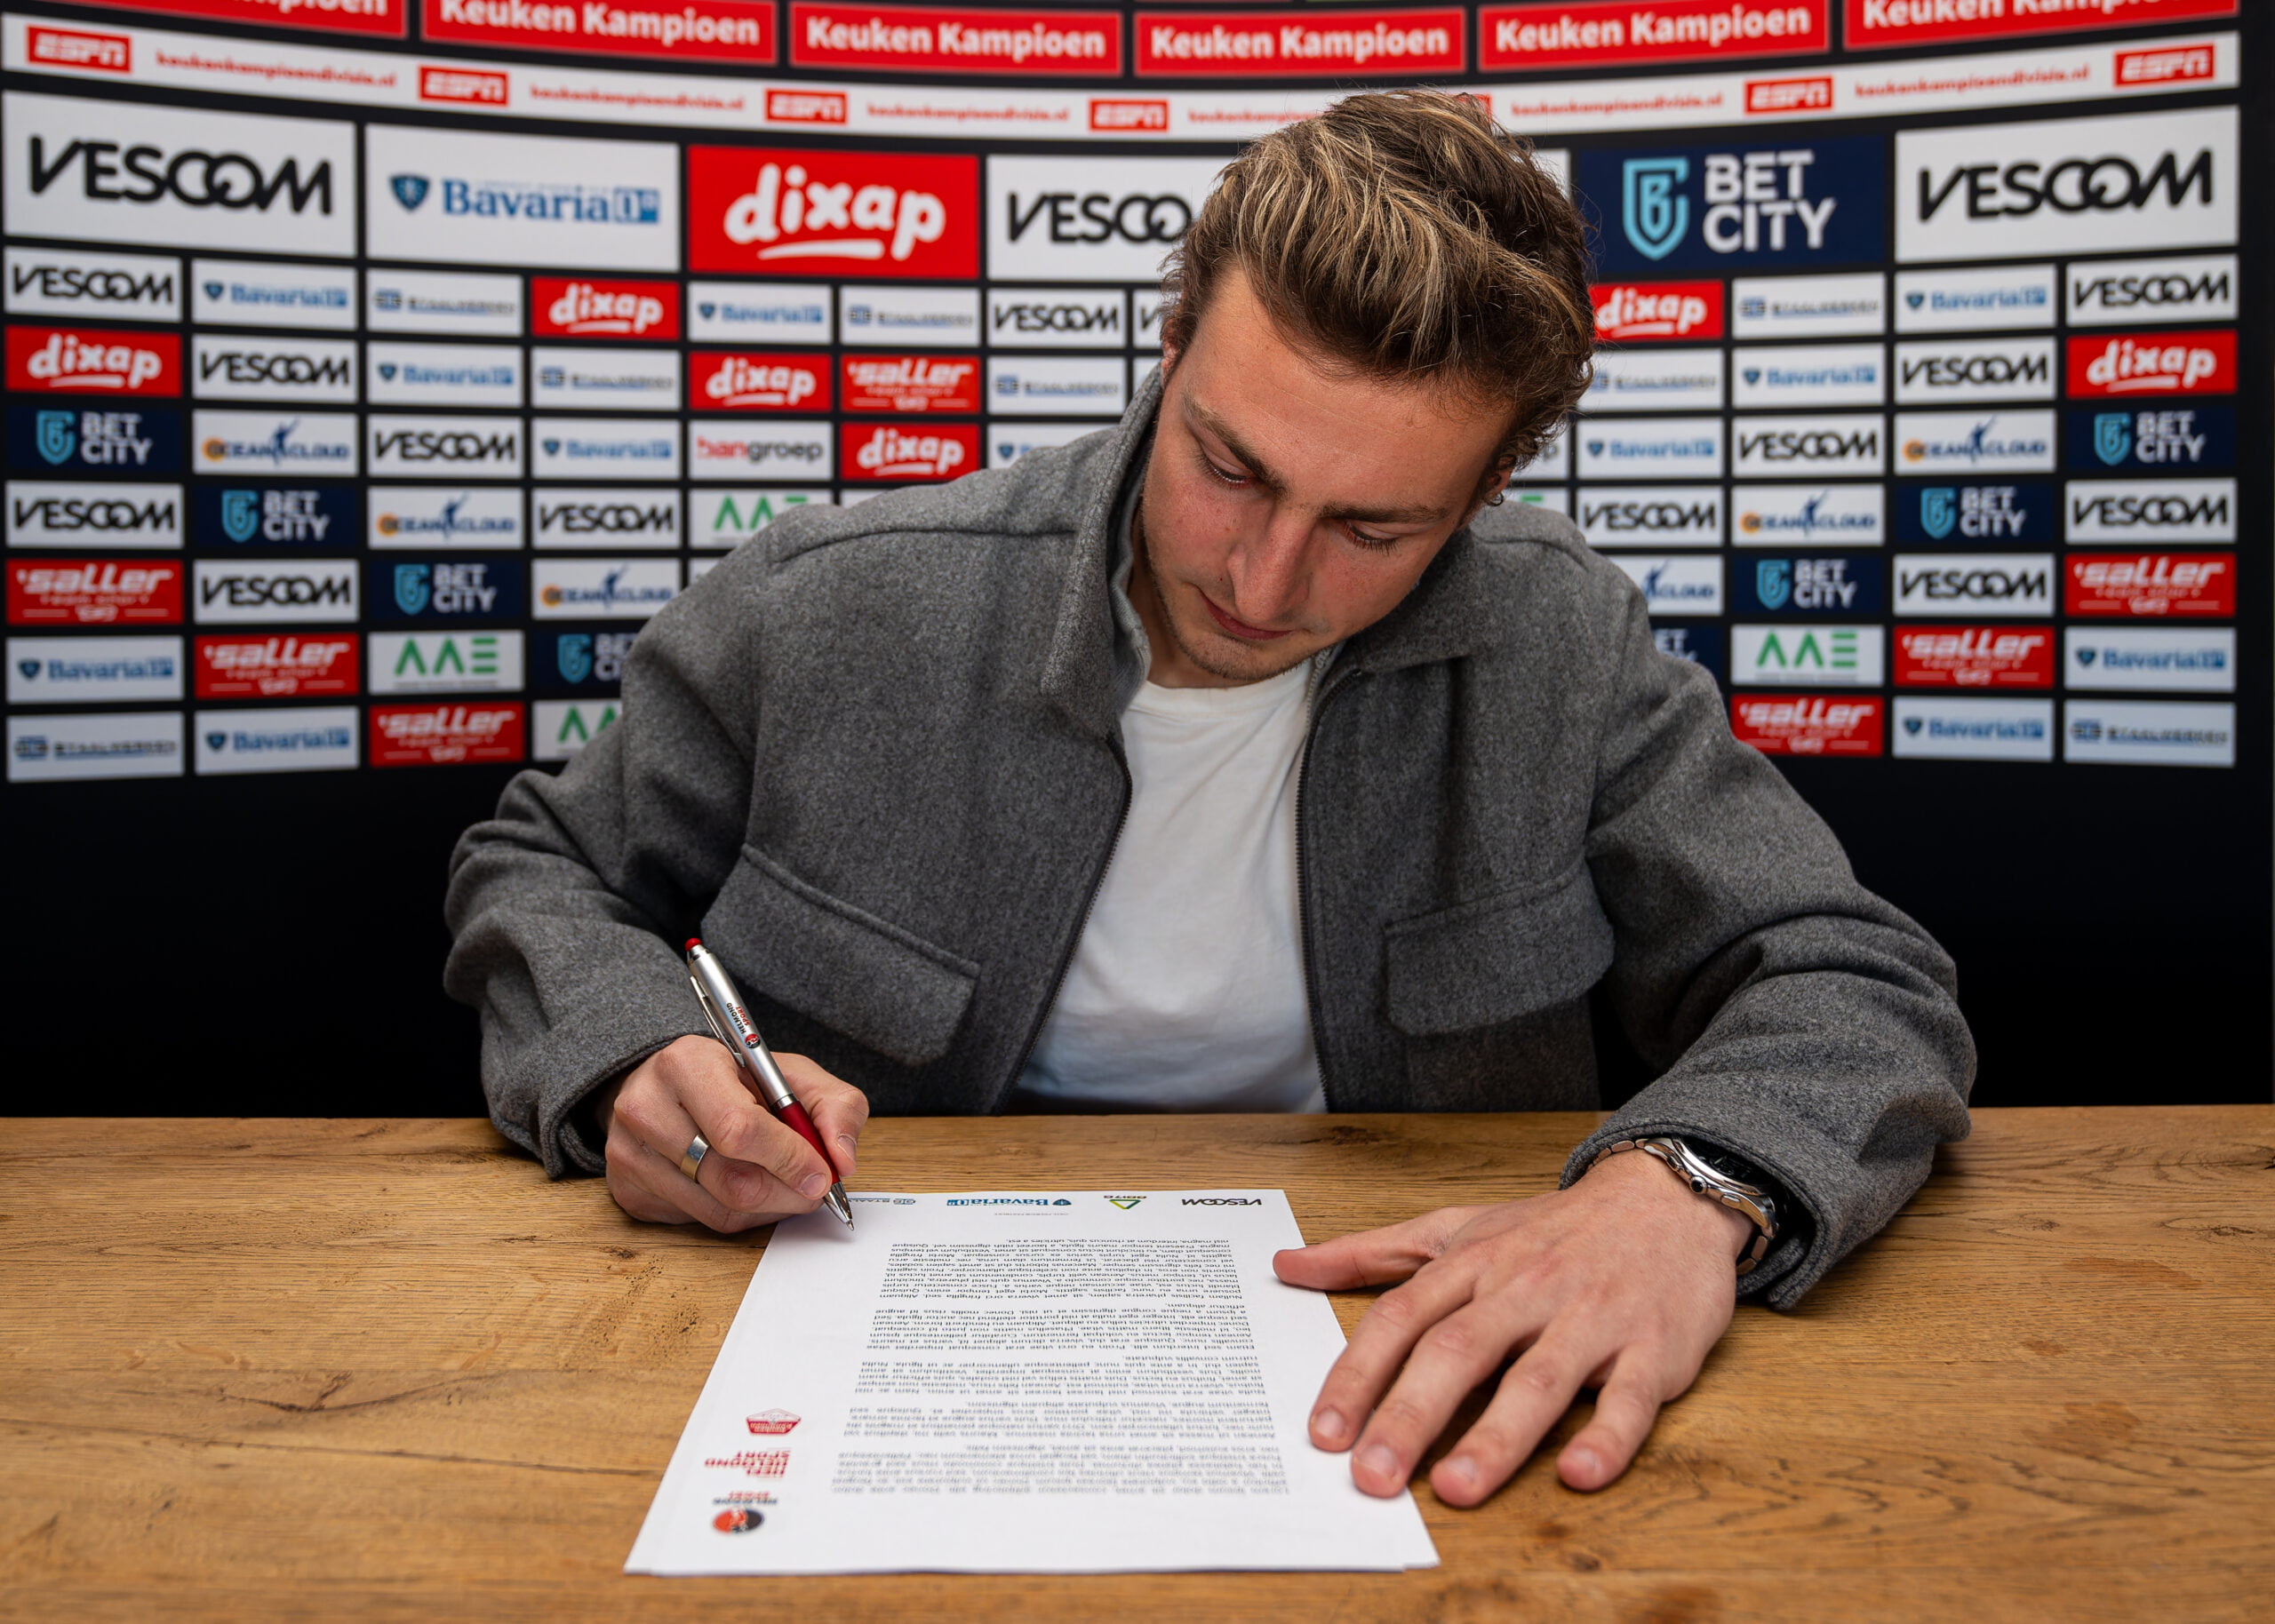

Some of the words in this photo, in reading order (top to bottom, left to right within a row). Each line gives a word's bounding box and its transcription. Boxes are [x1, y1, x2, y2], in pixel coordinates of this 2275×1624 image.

[441, 0, 576, 33] Keuken
[582, 3, 760, 47] Kampioen
[1496, 16, 1624, 52] Keuken
[1630, 4, 1810, 47] Kampioen
[1864, 0, 2005, 29] Keuken
[34, 32, 127, 66] ESPN
[807, 16, 932, 53] Keuken
[938, 22, 1106, 63] Kampioen
[1151, 25, 1273, 59] Keuken
[1281, 22, 1449, 64] Kampioen
[2120, 50, 2210, 81] ESPN
[425, 72, 505, 101] ESPN
[1749, 82, 1829, 109] ESPN
[770, 93, 842, 121] ESPN
[1094, 104, 1164, 128] ESPN
[29, 136, 332, 216] VESCOM
[1704, 150, 1815, 204] BET
[1917, 147, 2213, 224] VESCOM
[442, 177, 610, 222] Bavaria
[724, 163, 946, 260] dixap
[1007, 192, 1193, 243] VESCO
[1703, 197, 1837, 253] CITY
[12, 263, 174, 305] VESCOM
[2073, 273, 2231, 310] VESCOM
[548, 283, 664, 334] dixap
[994, 304, 1120, 331] VESCOM
[1598, 287, 1707, 334] dixap
[28, 333, 163, 388] dixap
[200, 353, 350, 387] VESCOM
[848, 357, 974, 386] saller
[1901, 354, 2048, 388] VESCOM
[2086, 339, 2216, 391] dixap
[706, 356, 817, 405] dixap
[81, 411, 141, 439] BET
[2136, 410, 2195, 437] BET
[80, 438, 153, 465] CITY
[374, 431, 516, 461] VESCOM
[857, 427, 965, 474] dixap
[1740, 431, 1877, 460] VESCOM
[2136, 434, 2206, 463] CITY
[15, 498, 175, 530] VESCOM
[263, 490, 320, 517] BET
[1960, 487, 2016, 513] BET
[2073, 497, 2228, 526] VESCOM
[263, 514, 330, 541] CITY
[539, 505, 673, 533] VESCOM
[1584, 502, 1716, 530] VESCOM
[1960, 510, 2027, 537] CITY
[16, 564, 174, 594] saller
[434, 563, 488, 588] BET
[1793, 559, 1848, 585] BET
[1901, 570, 2047, 600] VESCOM
[2073, 556, 2225, 588] saller
[203, 576, 351, 605] VESCOM
[433, 586, 497, 613] CITY
[1793, 582, 1857, 609] CITY
[204, 638, 350, 668] saller
[1902, 629, 2045, 660] saller
[378, 706, 516, 737] saller
[1739, 698, 1874, 728] saller
[726, 1002, 747, 1035] HELMOND
[735, 1006, 751, 1026] SPORT
[1181, 1198, 1263, 1206] VESCOM
